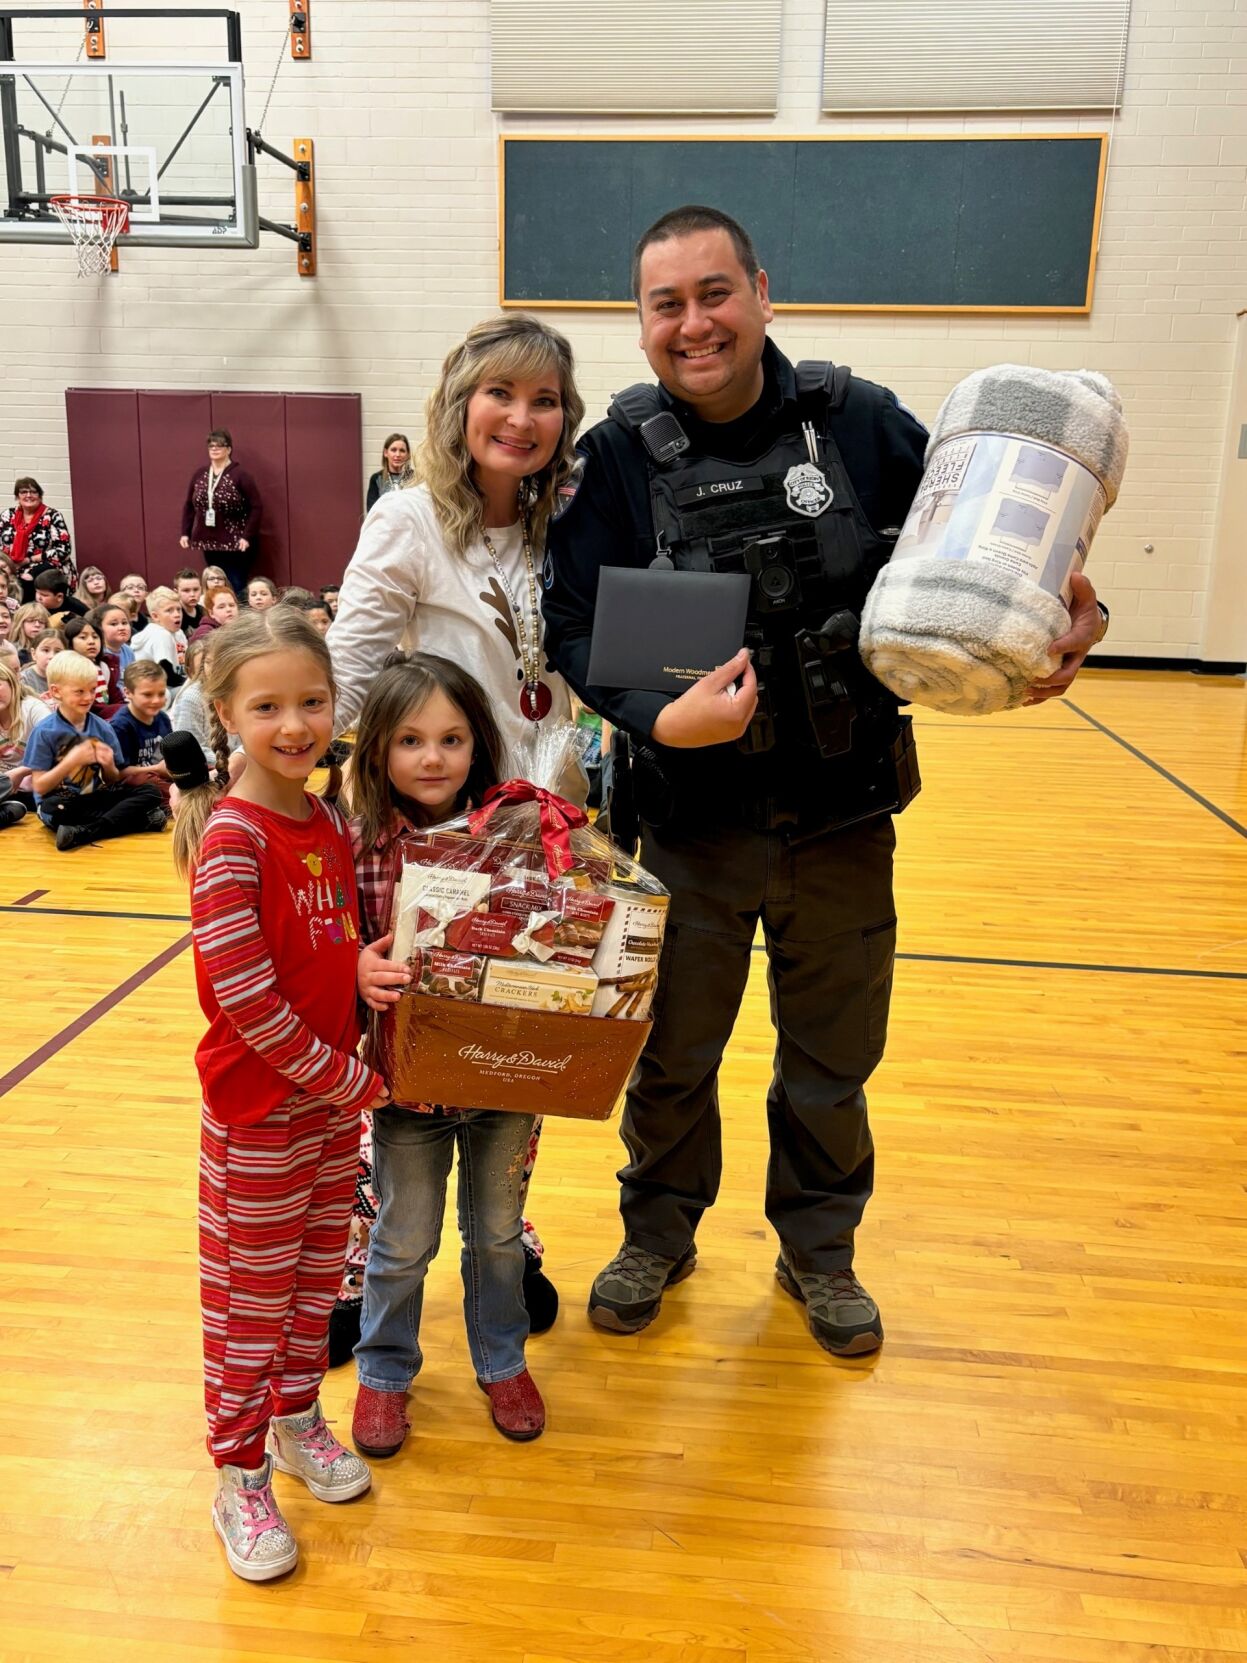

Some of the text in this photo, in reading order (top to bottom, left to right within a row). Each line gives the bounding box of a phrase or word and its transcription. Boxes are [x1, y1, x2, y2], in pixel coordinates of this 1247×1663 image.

[696, 480, 744, 497] J. CRUZ
[663, 666, 685, 675] Modern
[422, 885, 470, 896] CLASSIC CARAMEL
[509, 901, 530, 910] SNACK
[625, 955, 644, 963] WAFER
[494, 986, 539, 998] CRACKERS
[479, 1069, 541, 1082] MEDFORD, OREGON
